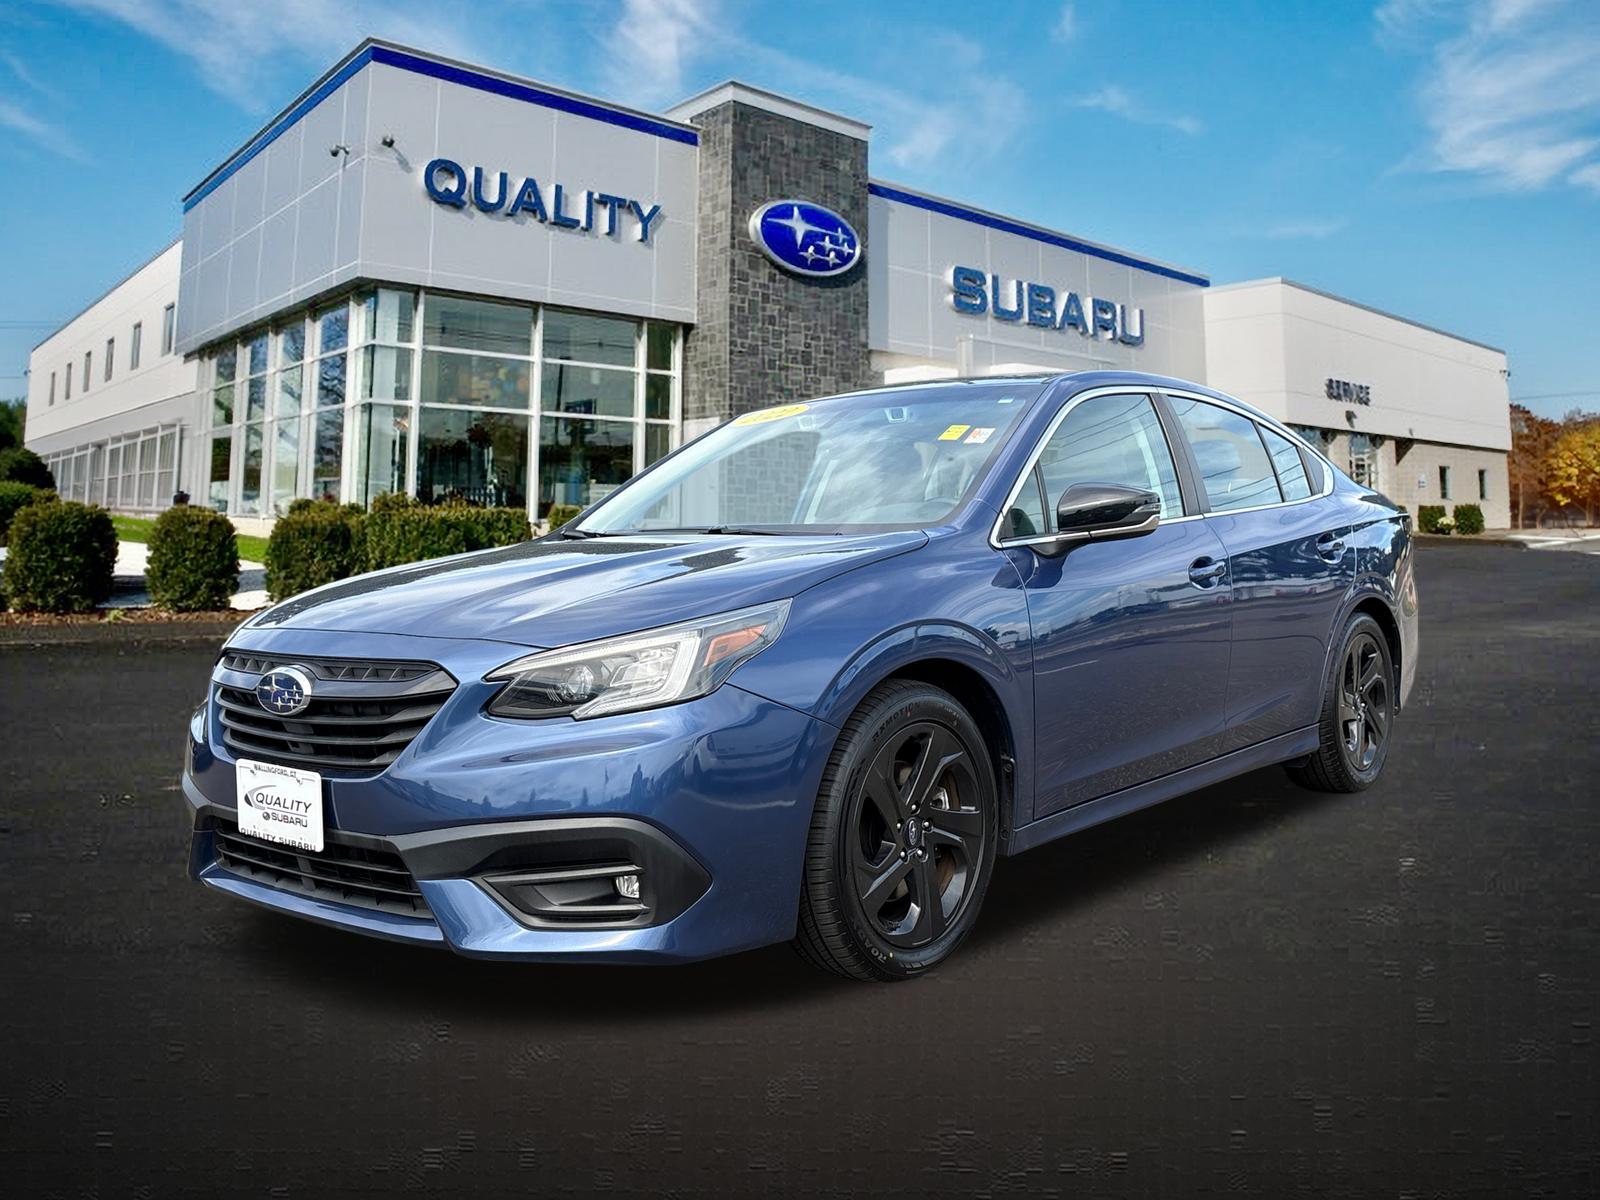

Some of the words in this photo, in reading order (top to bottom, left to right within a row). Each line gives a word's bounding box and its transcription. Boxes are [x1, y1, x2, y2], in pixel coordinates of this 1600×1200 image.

[422, 158, 662, 243] QUALITY
[945, 264, 1145, 347] SUBARU
[1325, 377, 1371, 406] SERVICE
[255, 792, 312, 814] QUALITY
[271, 812, 308, 828] SUBARU
[240, 827, 276, 842] QUALITY
[279, 837, 317, 851] SUBARU
